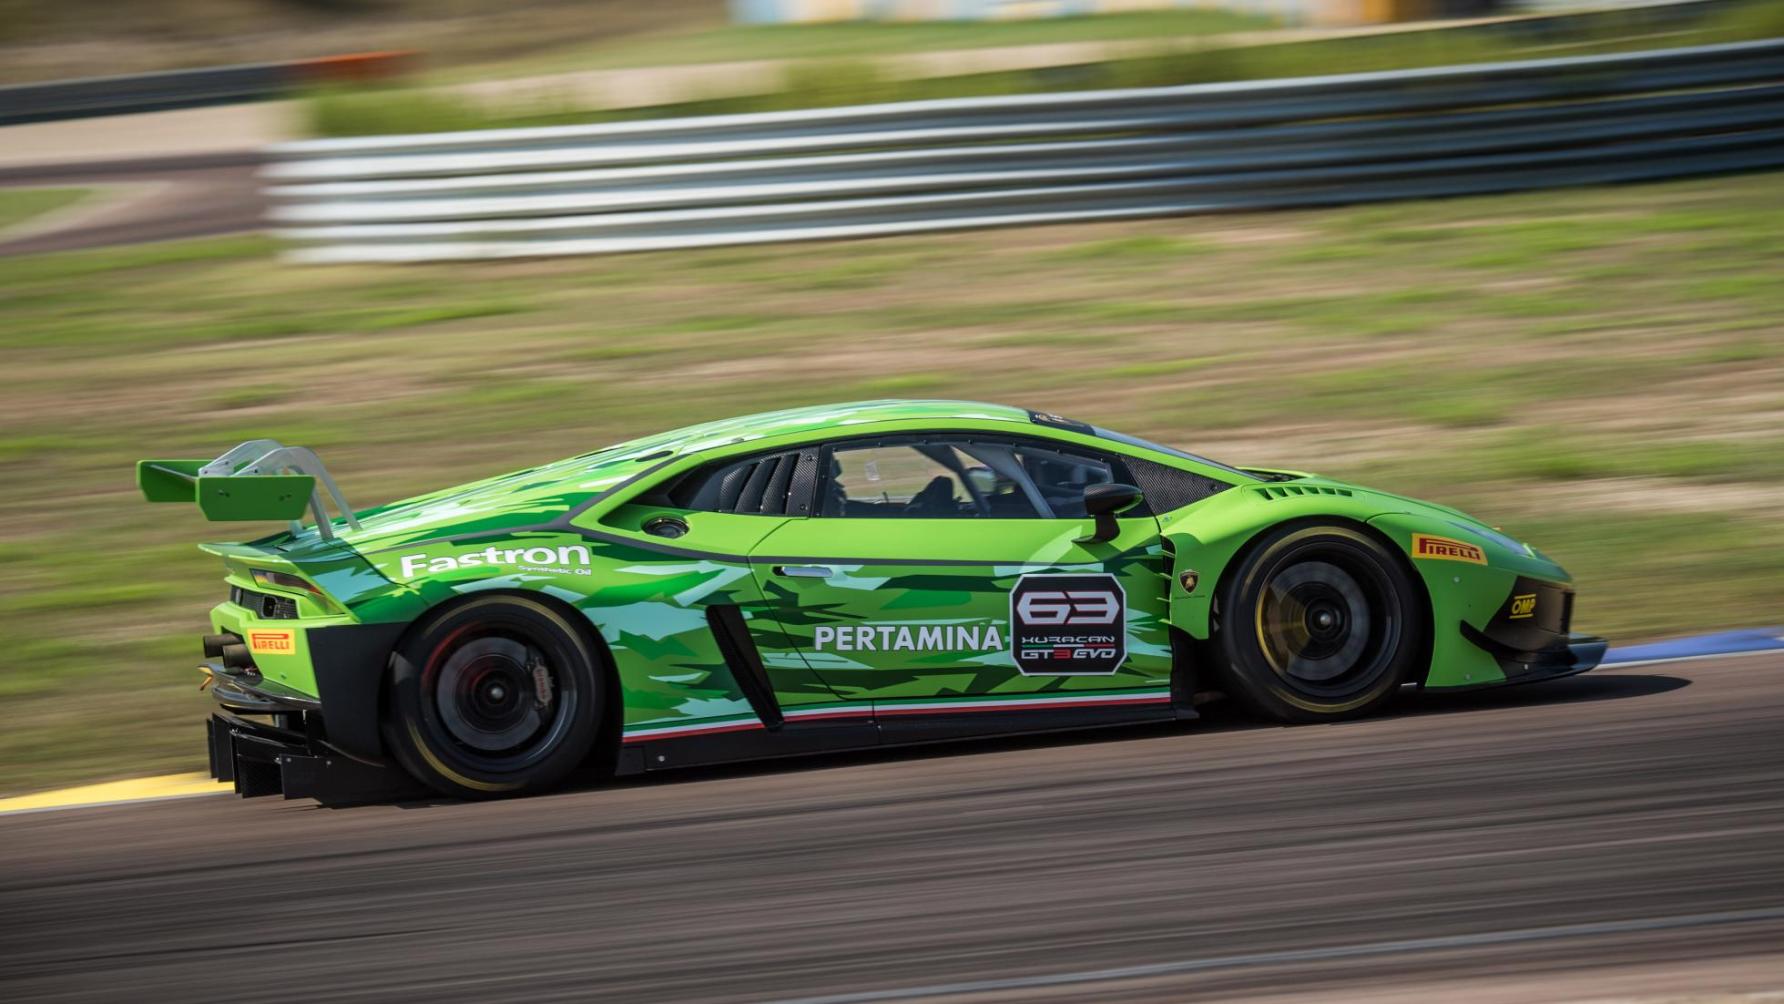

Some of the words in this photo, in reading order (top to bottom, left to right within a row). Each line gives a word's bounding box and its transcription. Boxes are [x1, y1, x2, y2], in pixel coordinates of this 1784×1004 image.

[1418, 537, 1481, 560] PIRELLI
[400, 545, 590, 579] Fastron
[574, 568, 592, 576] Oil
[1016, 591, 1120, 625] 63
[1511, 598, 1536, 615] OMP
[251, 633, 290, 650] PIRELLI
[814, 625, 1004, 651] PERTAMINA
[1021, 635, 1116, 644] HURACAN
